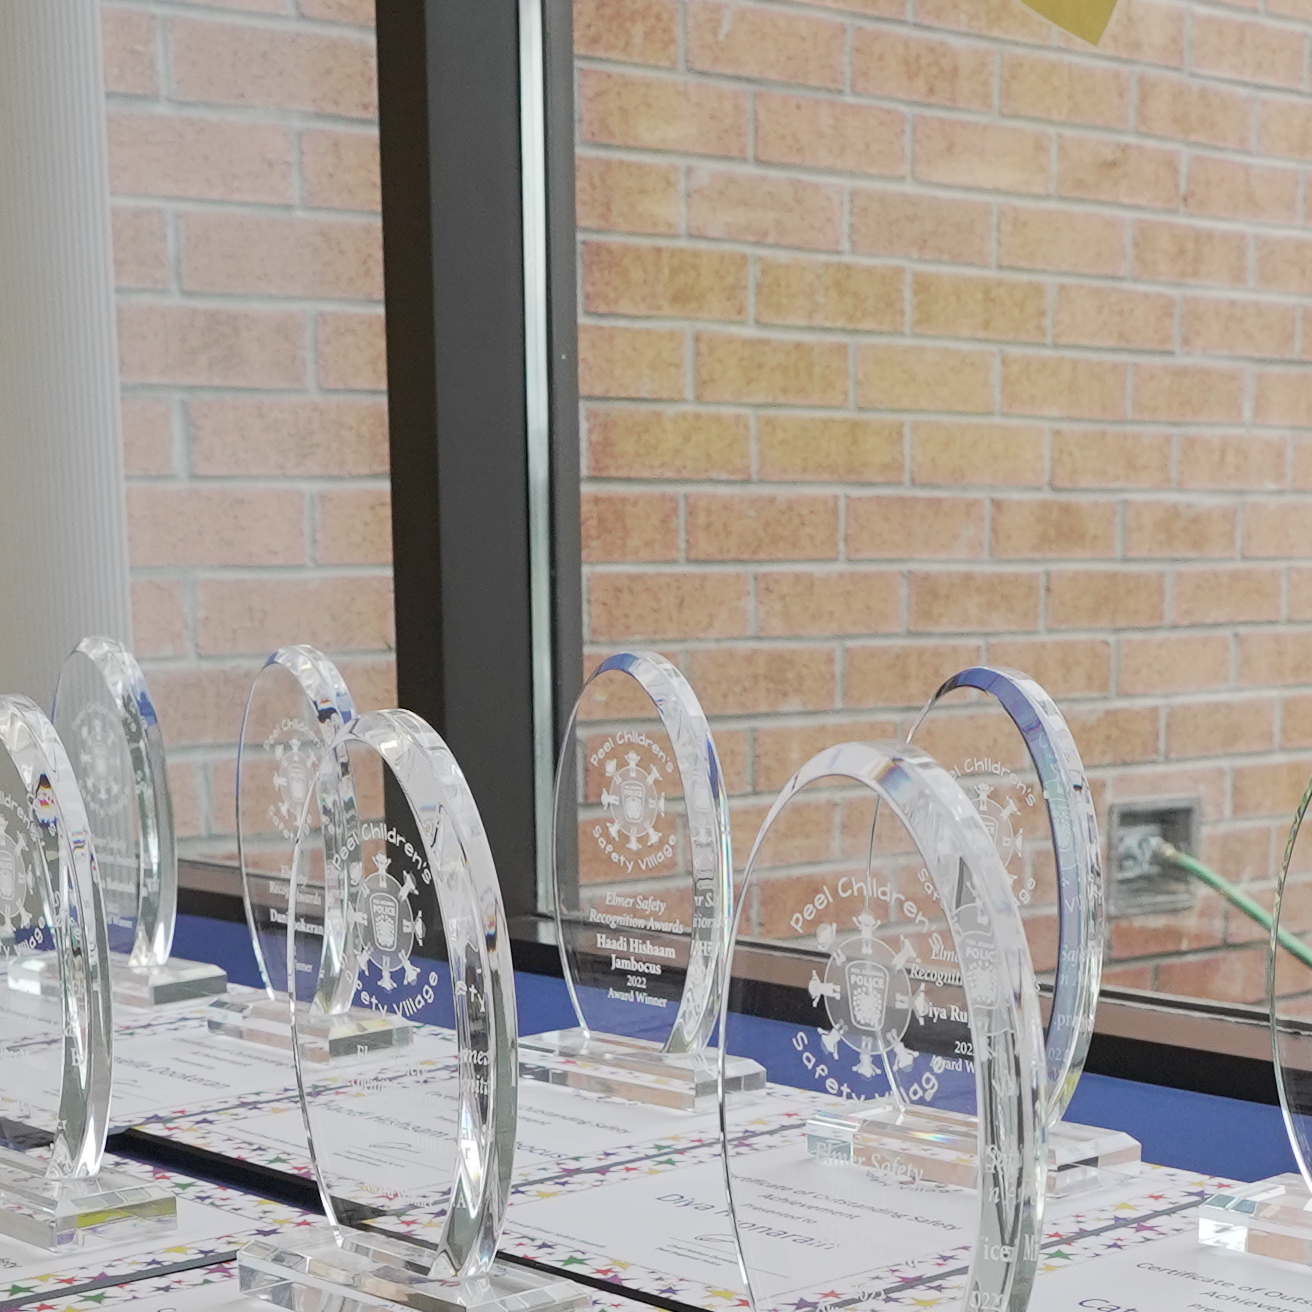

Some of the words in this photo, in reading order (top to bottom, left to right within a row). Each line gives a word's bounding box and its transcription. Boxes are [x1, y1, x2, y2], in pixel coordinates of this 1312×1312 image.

[616, 731, 675, 774] Children's
[361, 822, 431, 884] Children's
[592, 824, 634, 873] Safety
[639, 834, 677, 871] Village
[605, 892, 636, 910] Elmer
[636, 895, 666, 915] Safety
[790, 885, 833, 933] Peel
[838, 877, 945, 951] Children's
[589, 909, 645, 931] Recognition
[646, 918, 684, 934] Awards
[596, 933, 628, 952] Haadi
[629, 938, 676, 959] Hishaam
[610, 955, 662, 975] Jambocus
[391, 970, 439, 1017] Village
[626, 975, 647, 988] 2022
[850, 974, 885, 988] POLICE
[607, 987, 634, 1004] Award
[634, 992, 667, 1008] Winner
[870, 1153, 924, 1188] Safety
[1136, 1263, 1234, 1286] Certificate
